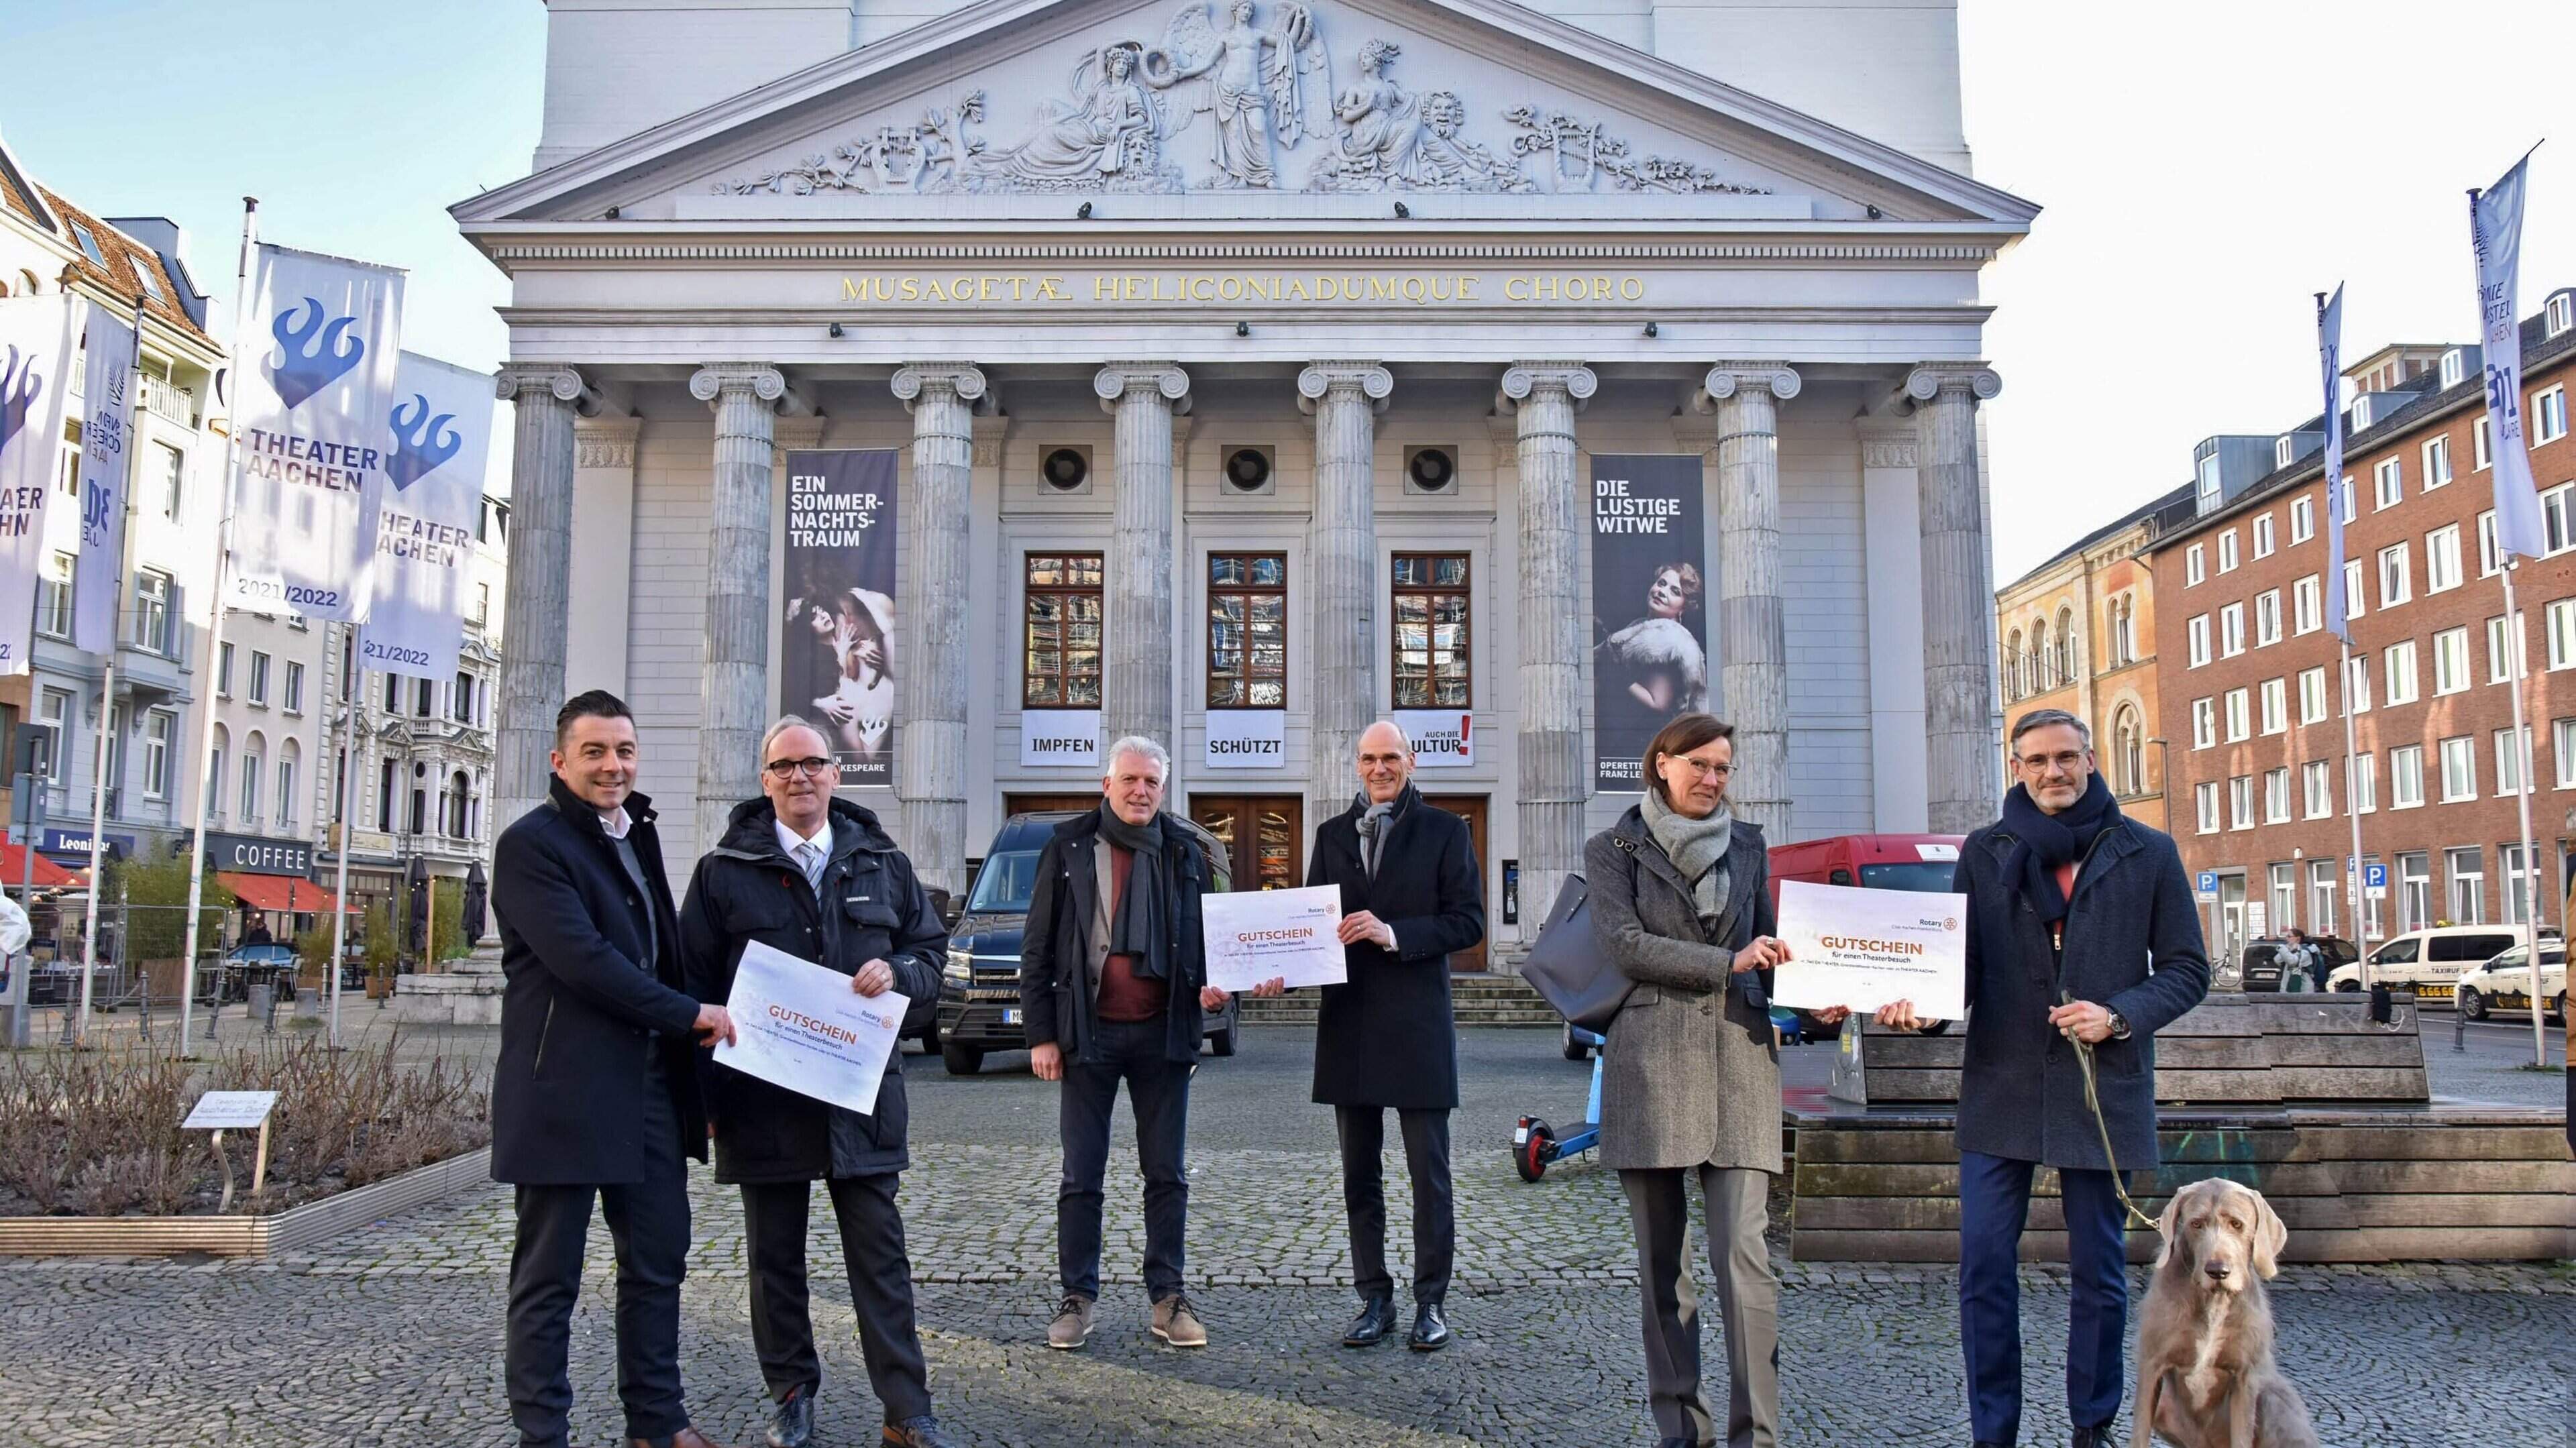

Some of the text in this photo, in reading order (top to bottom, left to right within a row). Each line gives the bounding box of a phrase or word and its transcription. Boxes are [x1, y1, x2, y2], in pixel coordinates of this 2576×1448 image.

[1093, 276, 1481, 304] HELICONIADUMQUE
[1504, 276, 1644, 301] CHORO
[250, 428, 378, 469] THEATER
[246, 454, 362, 494] AACHEN
[792, 476, 826, 492] EIN
[1596, 480, 1630, 497] DIE
[791, 493, 884, 511] SOMMER-
[1597, 498, 1680, 515] LUSTIGE
[791, 512, 875, 528] NACHTS-
[1596, 516, 1668, 533] WITWE
[381, 510, 469, 549] HEATER
[790, 531, 859, 547] TRAUM
[377, 535, 455, 568] ACHEN
[238, 578, 337, 606] 2021/2022
[1032, 738, 1094, 753] IMPFEN
[1210, 736, 1282, 754] SCHÜTZT
[840, 764, 885, 772] KESPEARE
[1600, 762, 1644, 770] OPERETTE
[1600, 771, 1644, 779] FRANZ LE
[235, 844, 305, 870] COFFEE
[2202, 875, 2212, 889] P
[2369, 867, 2381, 885] P
[1919, 919, 1942, 928] Rotary
[1238, 928, 1313, 942] GUTSCHEIN
[1821, 936, 1923, 955] GUTSCHEIN
[1862, 953, 1911, 964] Theaterbesuch
[861, 1009, 881, 1023] Rotary
[769, 1005, 857, 1045] GUTSCHEIN
[775, 1020, 843, 1051] für einen Theaterbesuch
